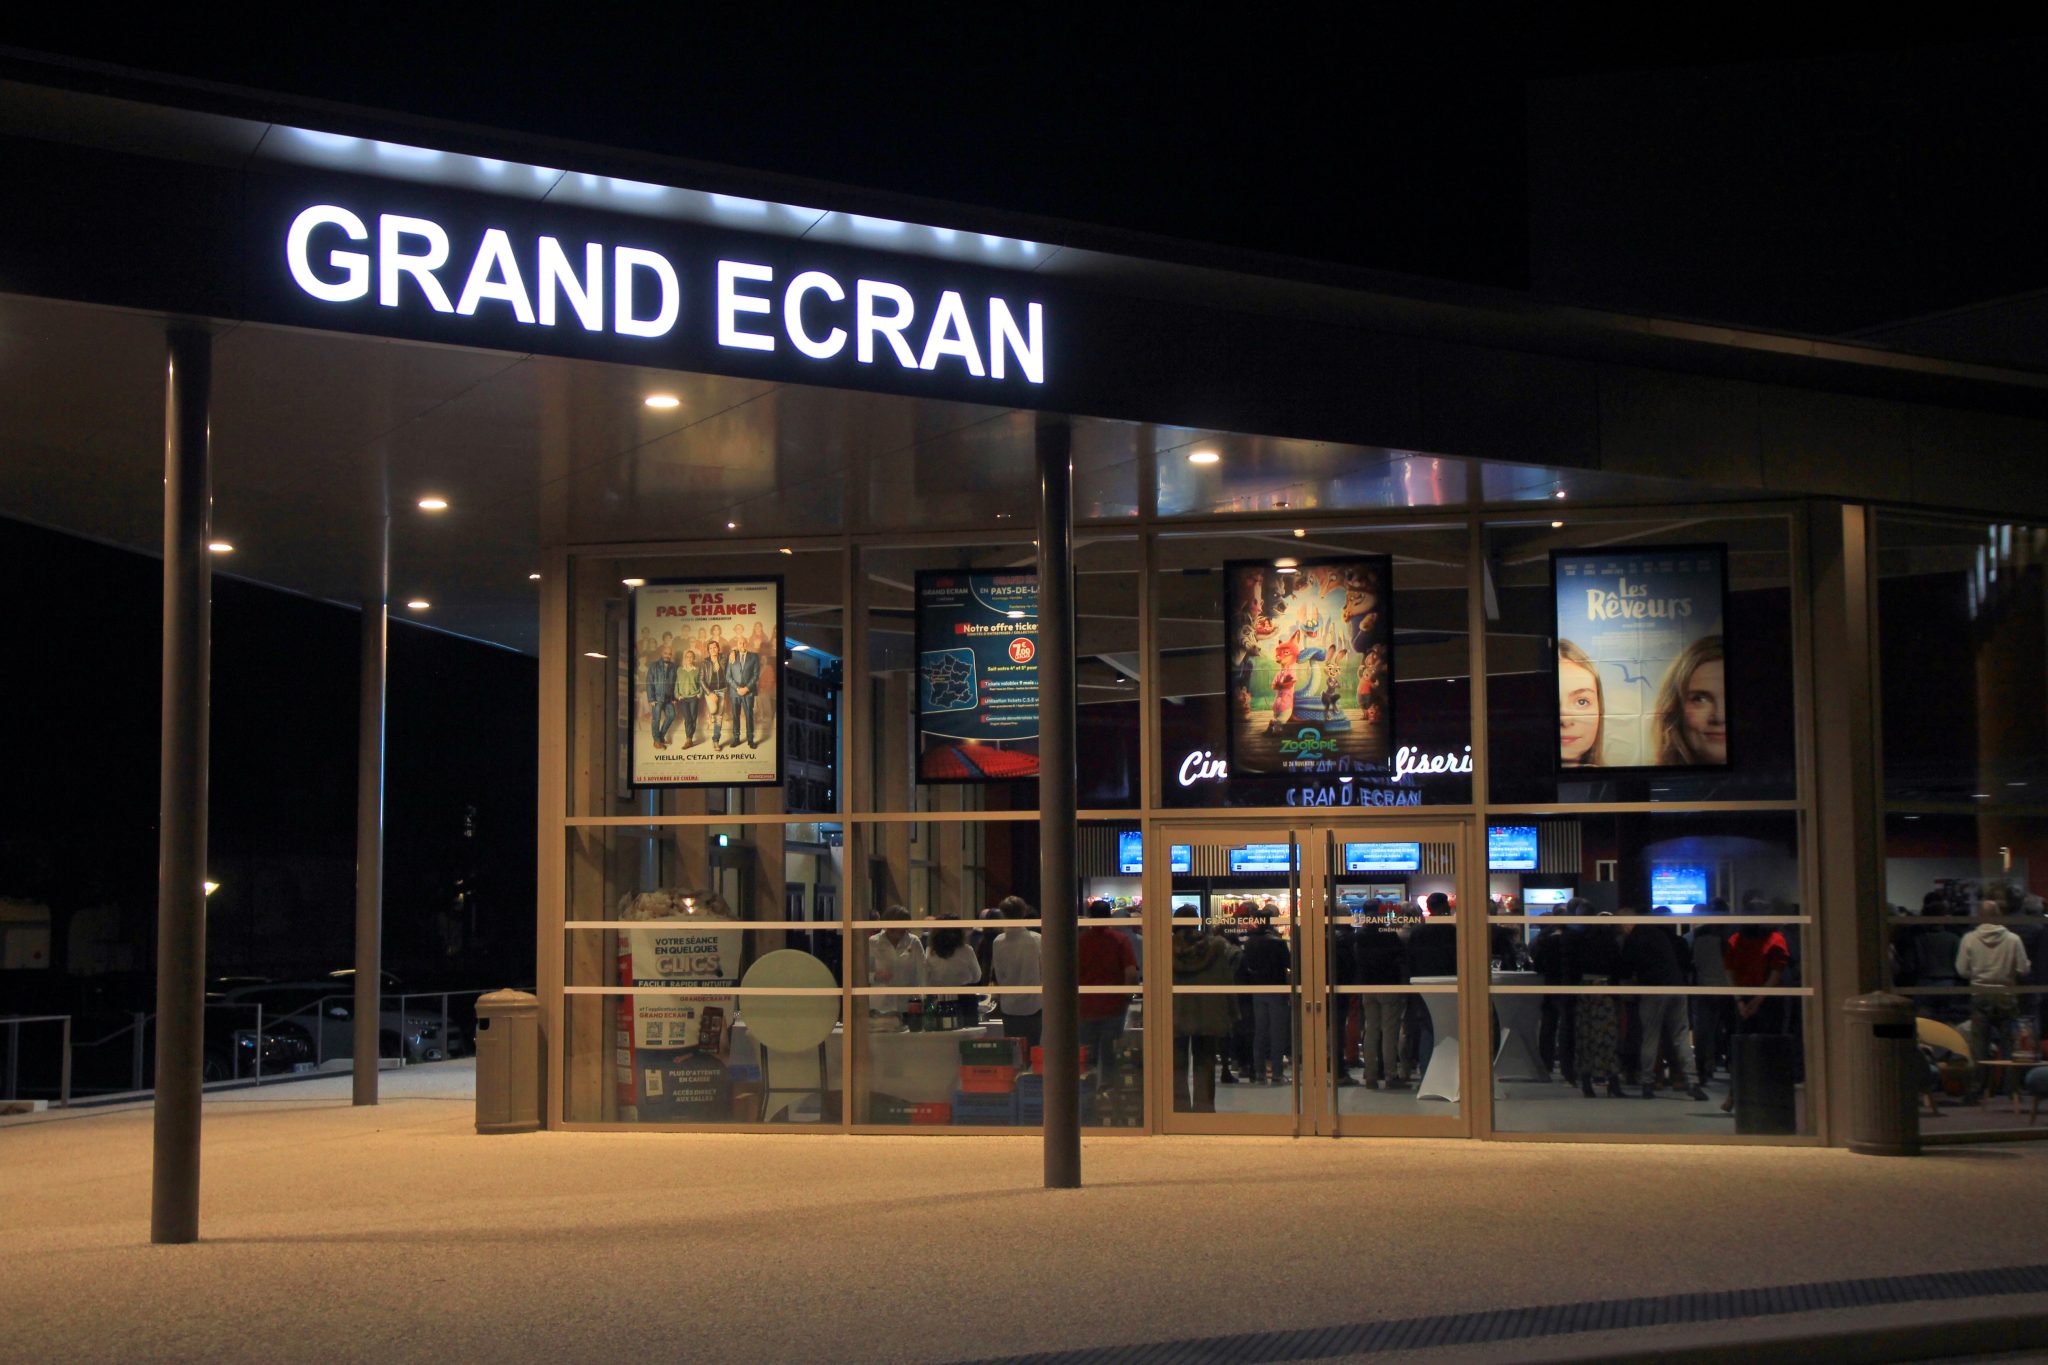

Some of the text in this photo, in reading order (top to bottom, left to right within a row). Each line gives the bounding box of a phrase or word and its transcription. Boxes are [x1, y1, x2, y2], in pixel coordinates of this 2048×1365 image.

[287, 203, 1045, 385] GRAND ECRAN
[1619, 577, 1648, 597] Les
[689, 592, 724, 605] T'AS
[1586, 588, 1692, 621] Rêveurs
[656, 602, 757, 617] PAS CHANGÉ
[963, 621, 1038, 633] Notre offre ticke
[1279, 737, 1339, 752] ZOOTOPIE
[686, 753, 714, 761] C'ÉTAIT
[1178, 750, 1228, 786] Cin
[1205, 916, 1266, 925] GRAND ECRAN
[1391, 916, 1421, 925] ECRAN
[655, 935, 718, 946] VOTRE SÉANCE
[655, 945, 718, 955] EN QUELQUES
[655, 954, 721, 977] CLICS
[702, 979, 733, 987] INTUITIF
